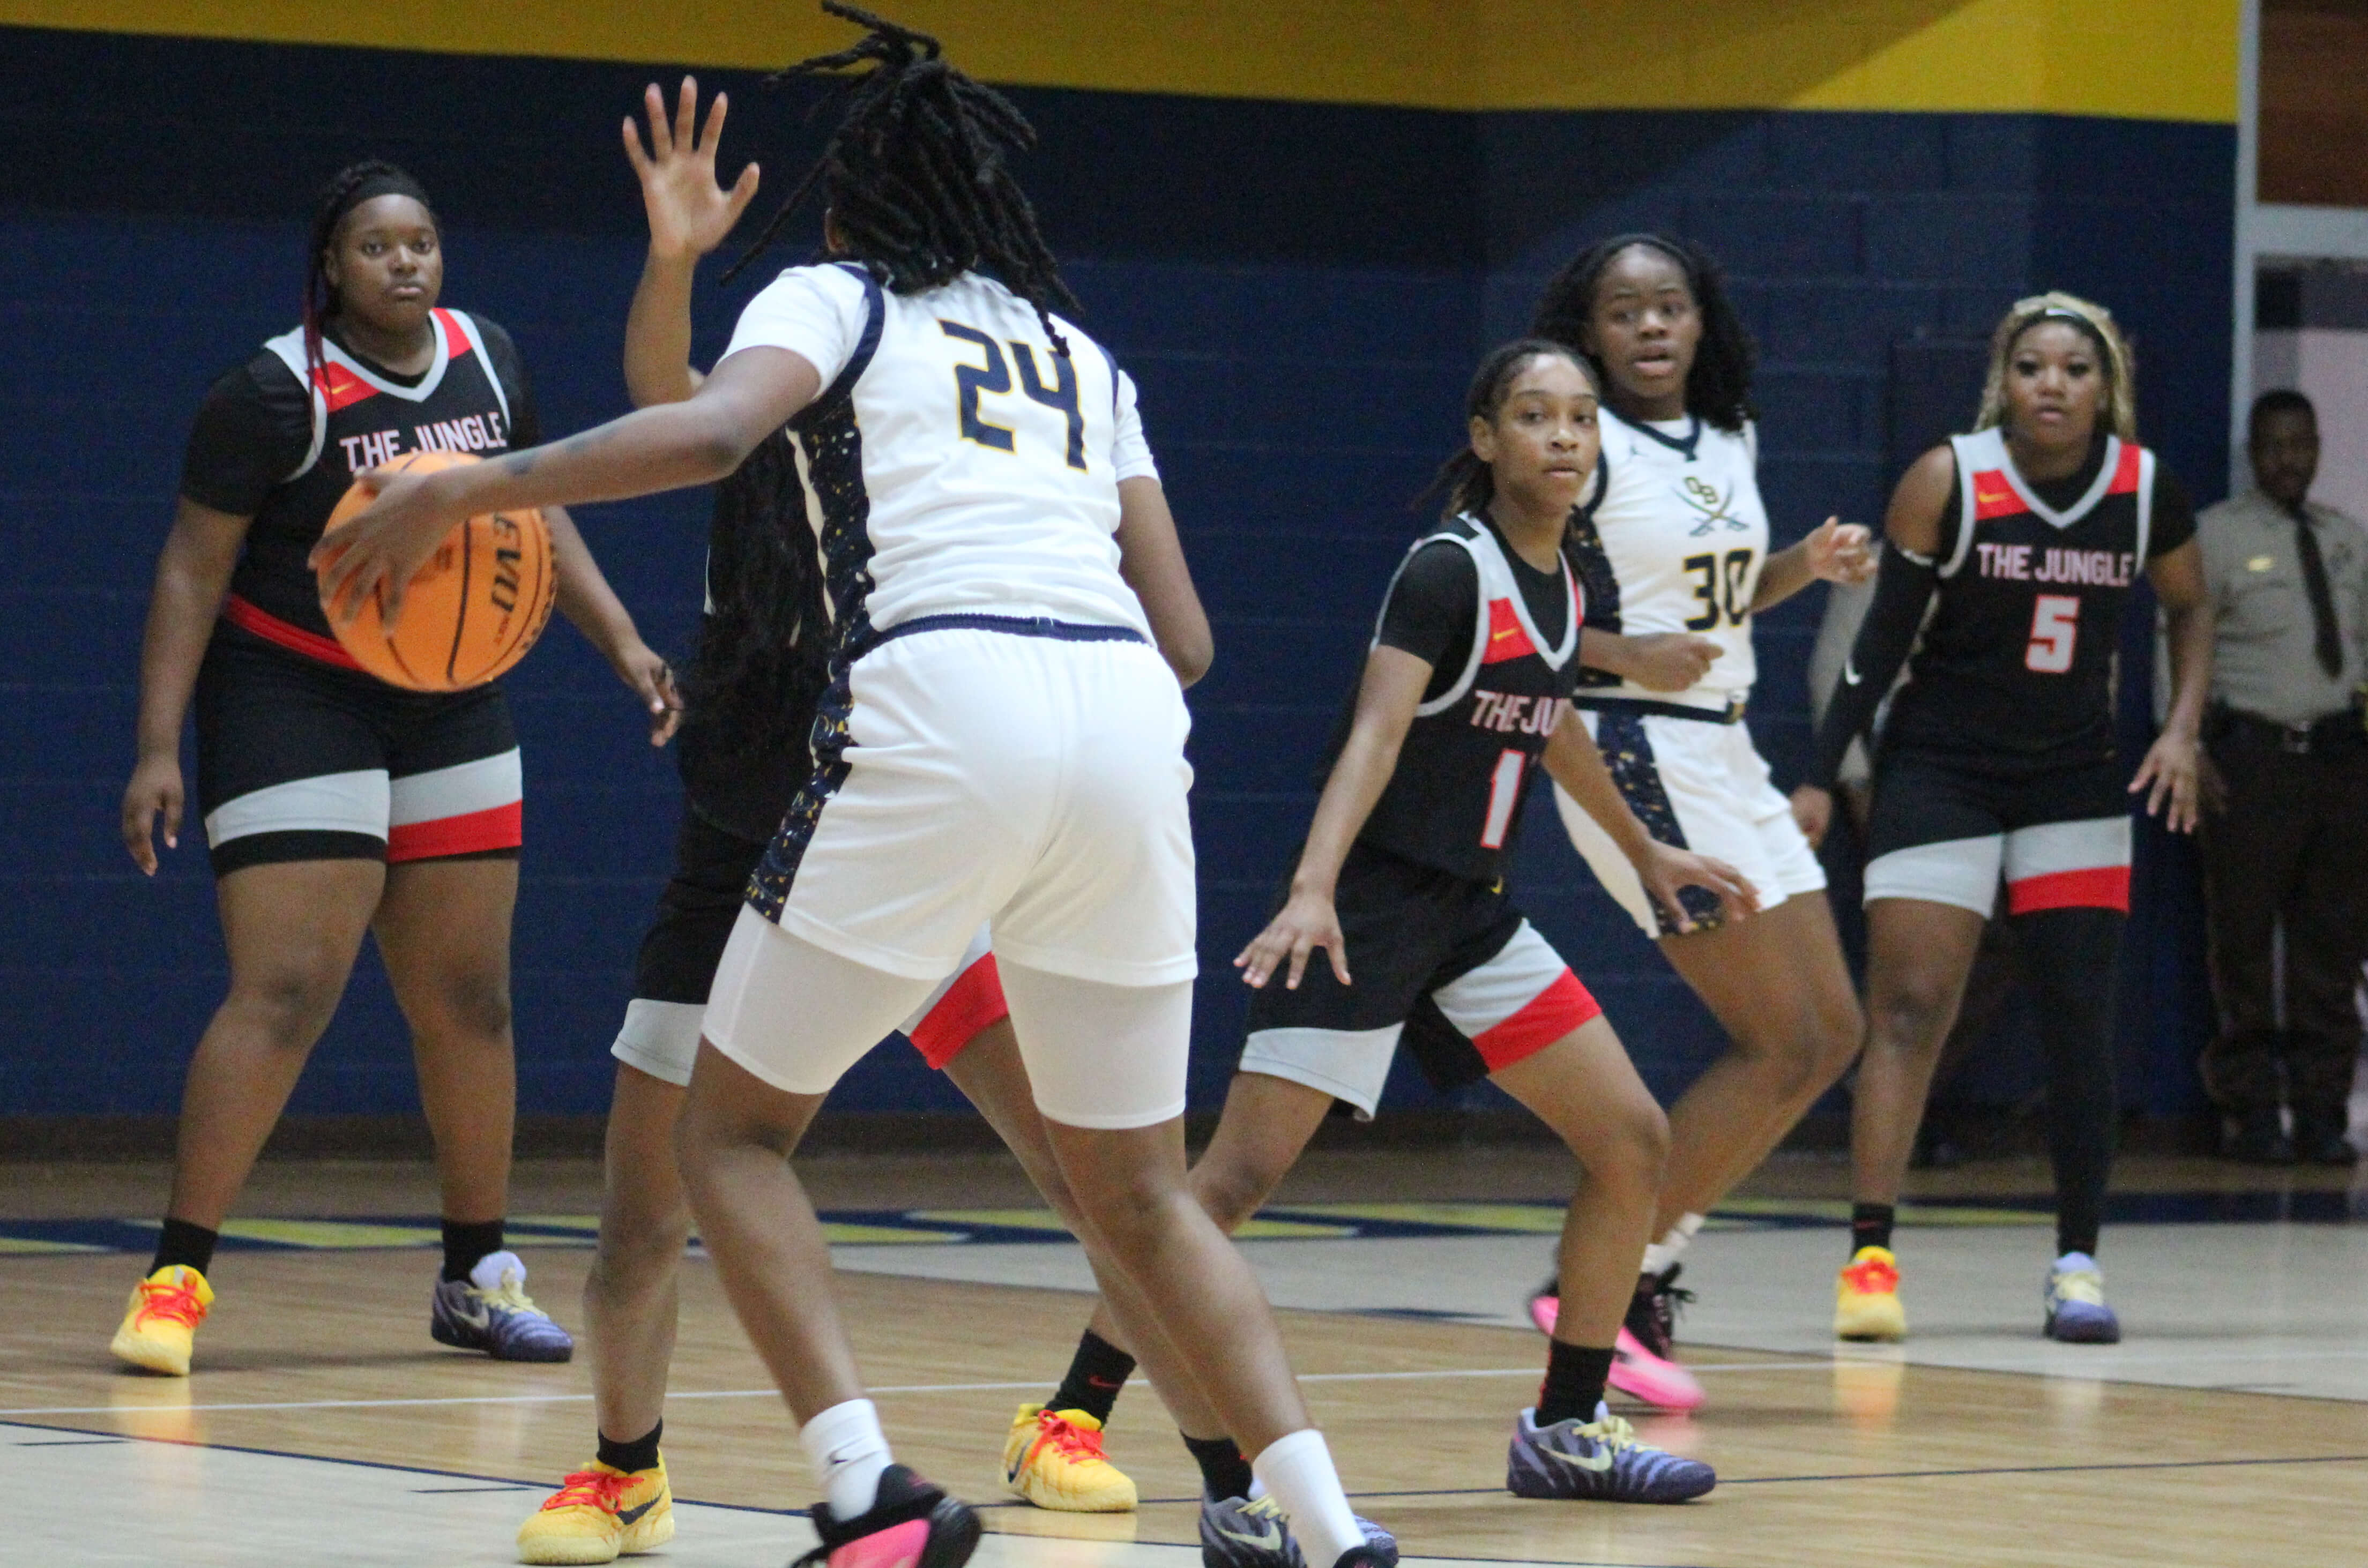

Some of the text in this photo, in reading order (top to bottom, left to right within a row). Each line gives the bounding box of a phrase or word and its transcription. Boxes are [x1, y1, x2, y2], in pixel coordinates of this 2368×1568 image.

[935, 318, 1089, 475] 24
[339, 412, 508, 473] THE JUNGLE
[1684, 548, 1754, 633] 30
[1976, 542, 2134, 587] THE JUNGLE
[2025, 593, 2080, 674] 5
[1470, 690, 1530, 732] THE
[1480, 748, 1525, 849] 1
